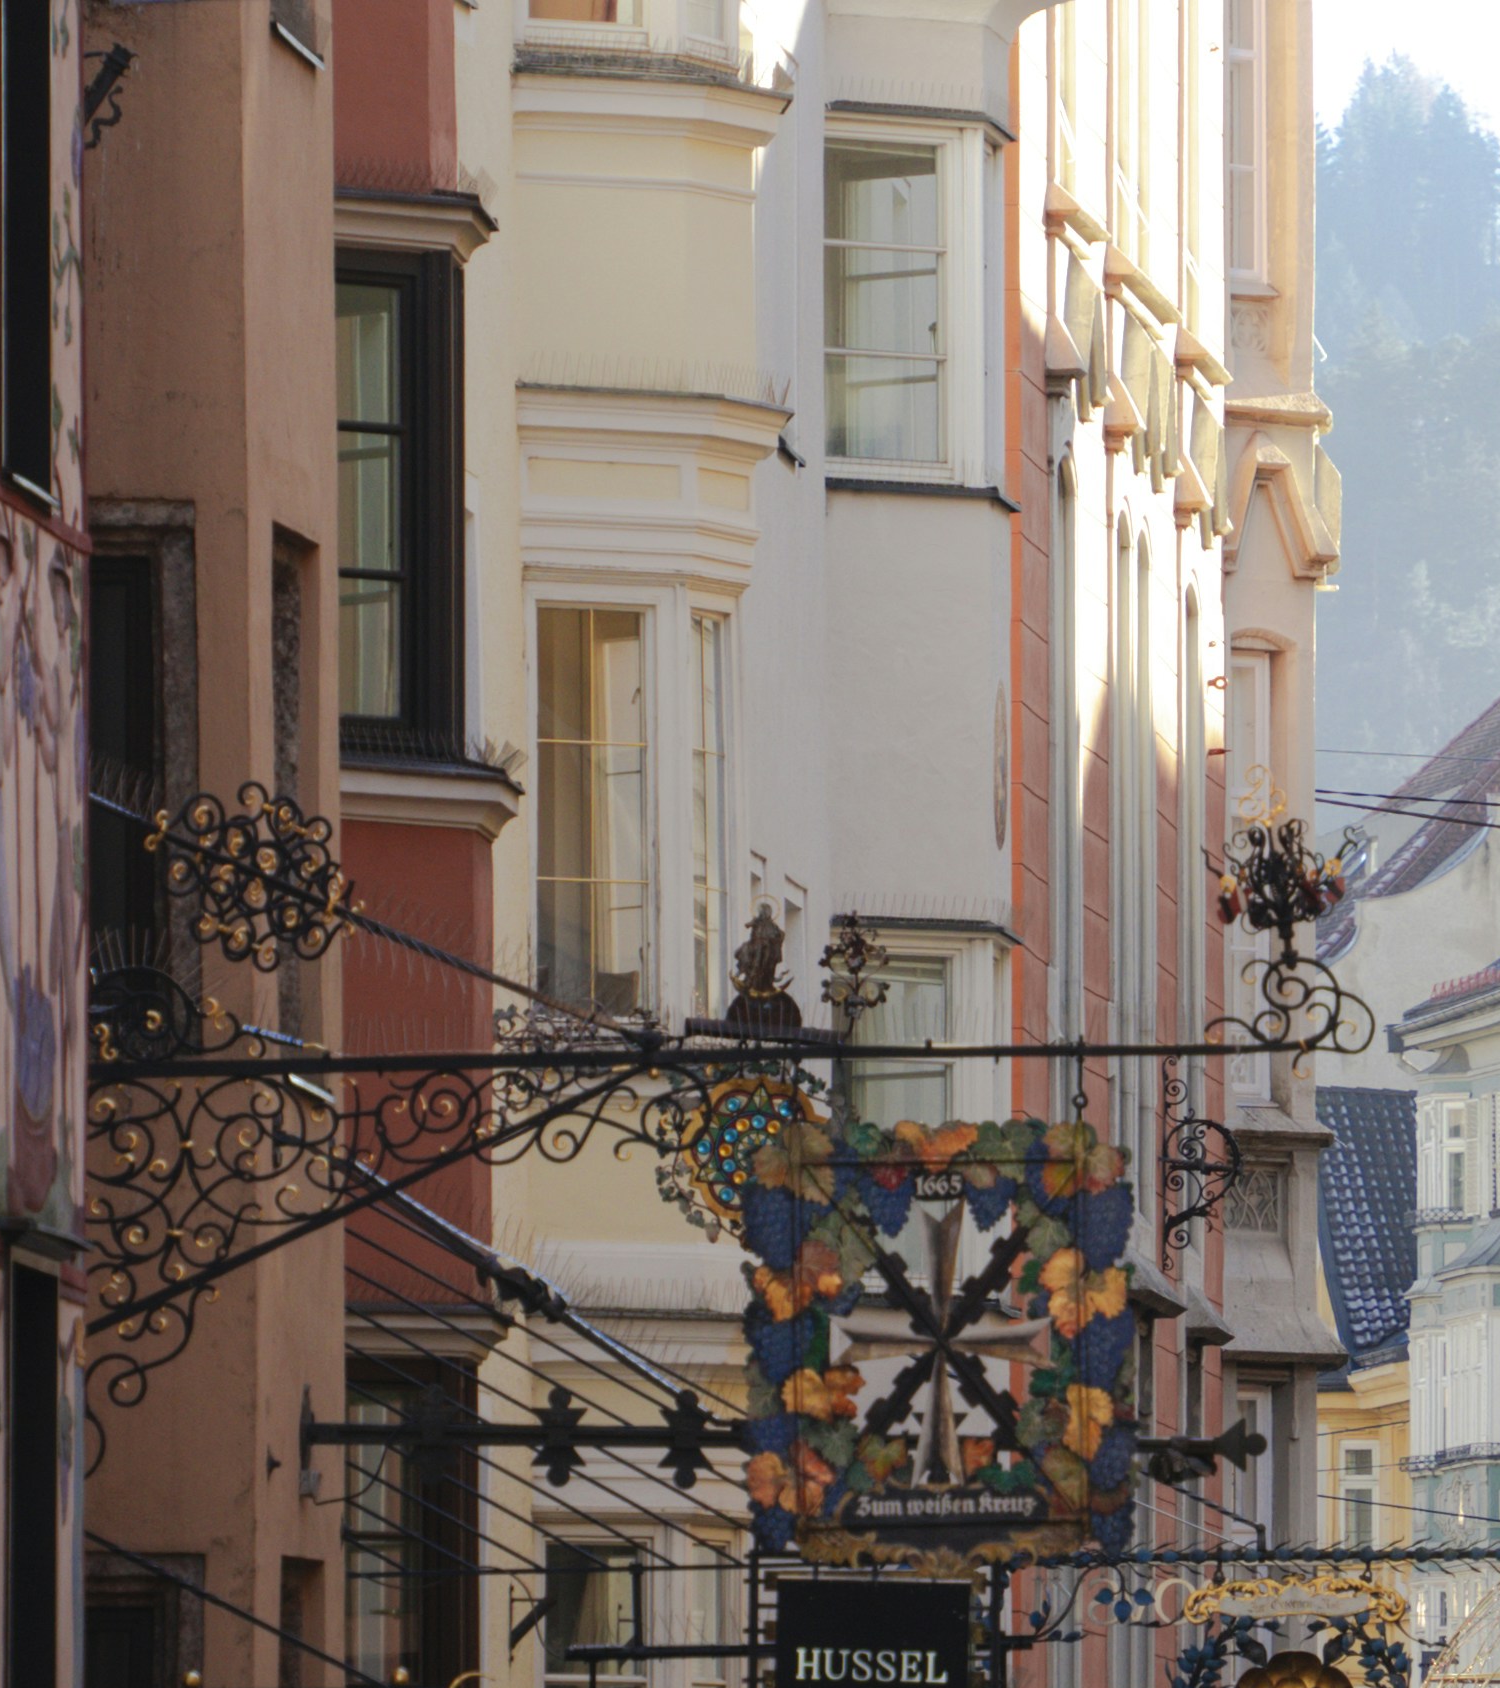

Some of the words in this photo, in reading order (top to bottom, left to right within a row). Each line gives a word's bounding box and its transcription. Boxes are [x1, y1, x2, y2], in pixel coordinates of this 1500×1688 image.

[914, 1174, 963, 1197] 1665
[855, 1496, 904, 1517] Zum
[906, 1495, 975, 1518] weißen
[977, 1493, 1038, 1518] Kreuz
[794, 1646, 948, 1686] HUSSEL
